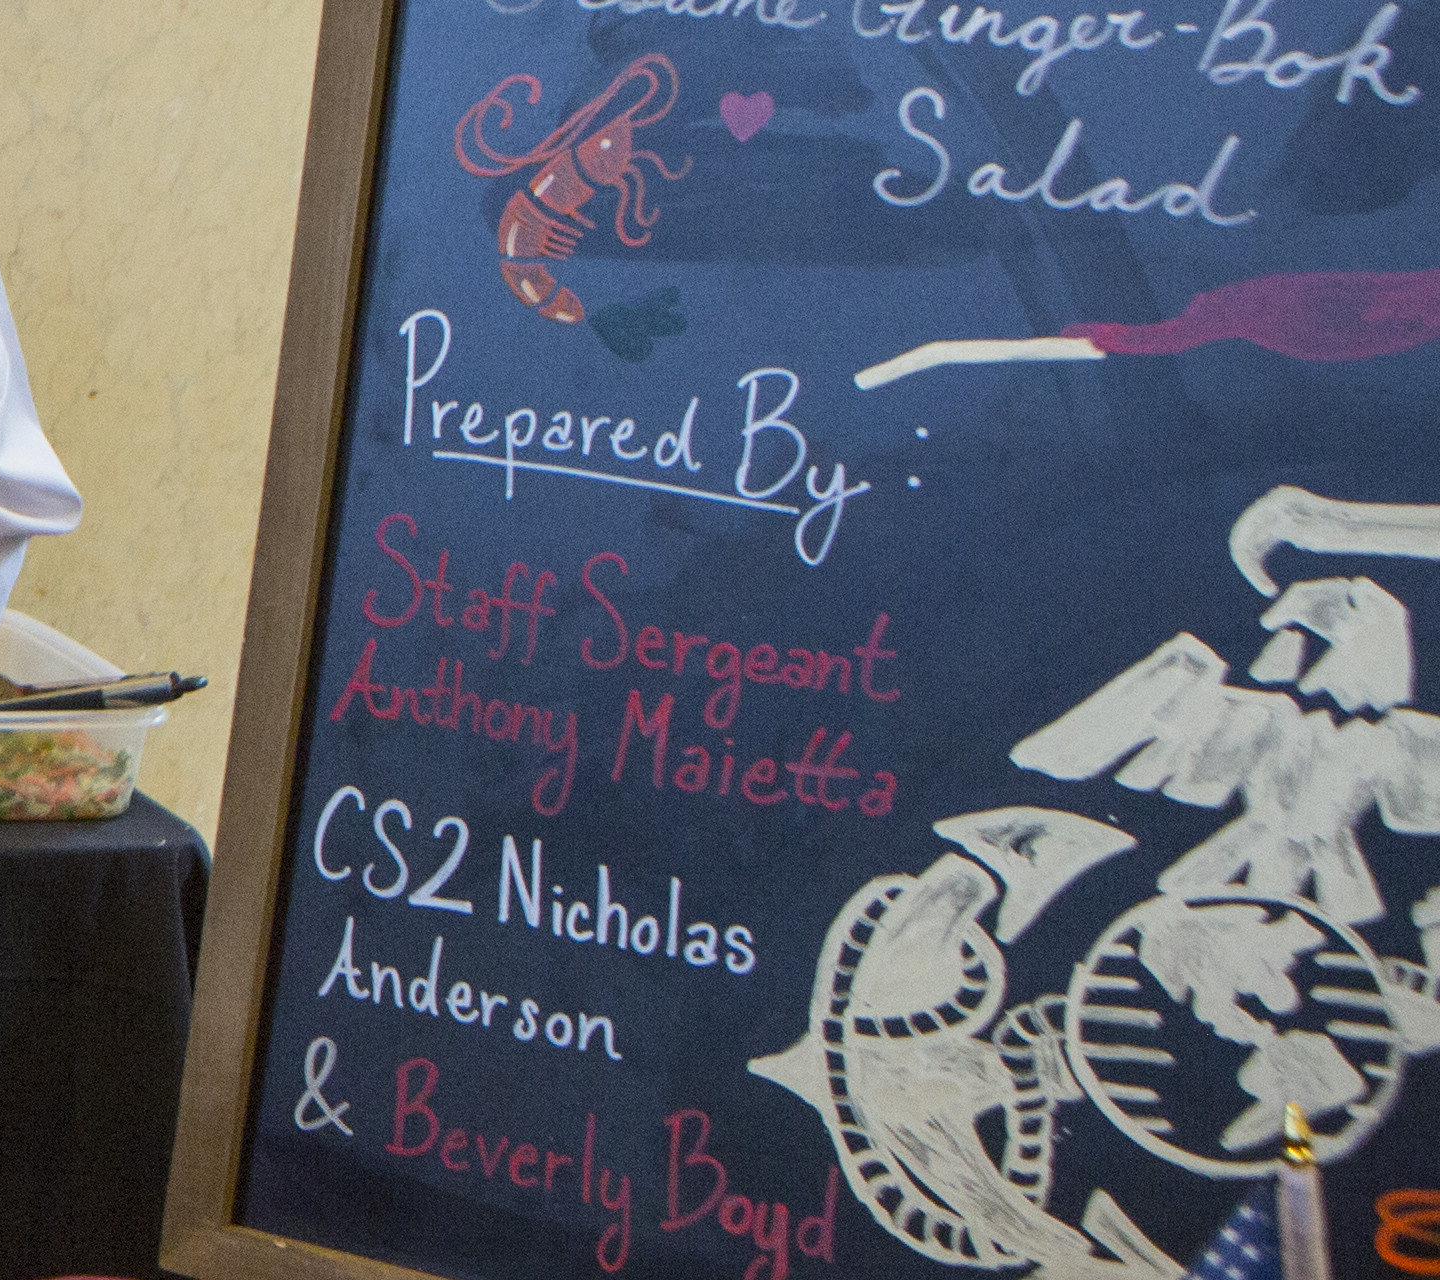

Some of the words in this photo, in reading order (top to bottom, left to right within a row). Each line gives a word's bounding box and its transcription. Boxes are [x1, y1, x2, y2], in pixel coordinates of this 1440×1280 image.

[873, 86, 1260, 225] Salad
[399, 310, 702, 499] Prepared
[362, 513, 558, 666] Staff
[580, 551, 902, 730] Sergeant
[330, 639, 579, 816] Anthony
[611, 689, 899, 818] Maietta
[313, 786, 473, 916] CS2
[498, 835, 756, 978] Nicholas
[318, 917, 623, 1061] Anderson
[293, 1036, 354, 1136] &
[385, 1058, 633, 1272] Beverly
